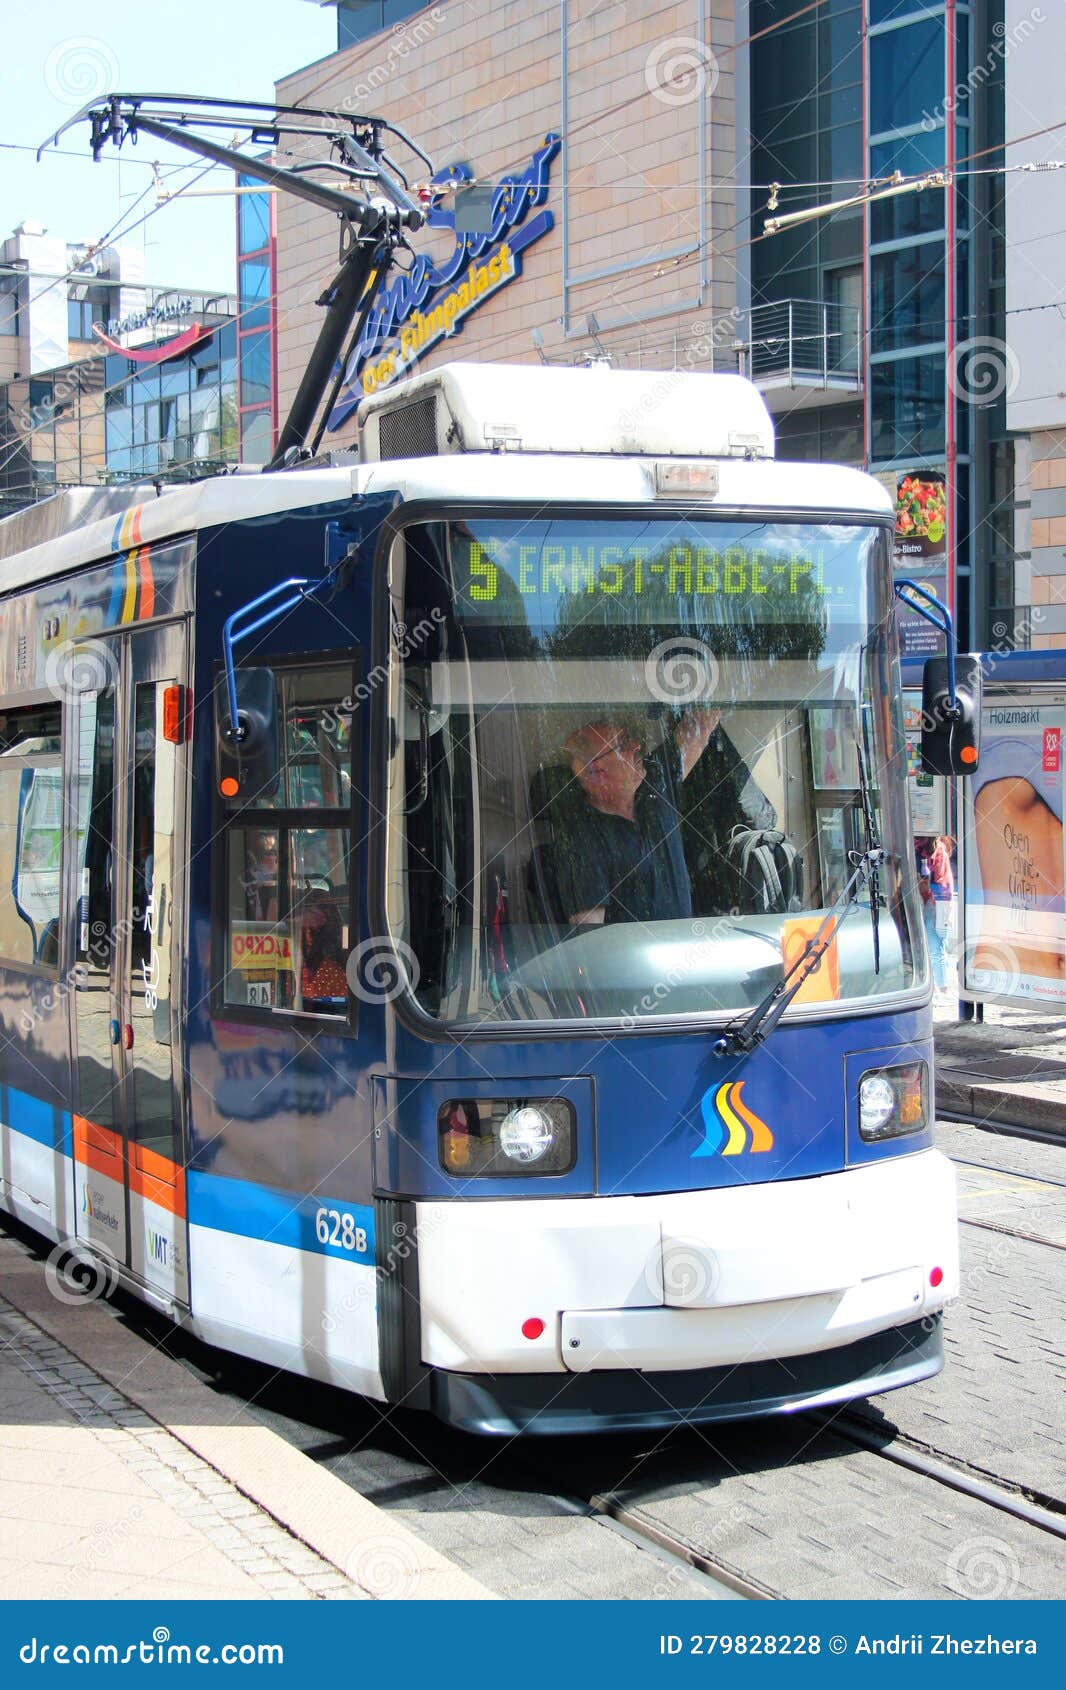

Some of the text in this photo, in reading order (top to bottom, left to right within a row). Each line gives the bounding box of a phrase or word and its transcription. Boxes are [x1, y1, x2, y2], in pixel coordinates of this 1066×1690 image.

[363, 243, 511, 395] Der Filmpalast
[469, 541, 845, 600] 5 ERNST-ABBE-PL.
[989, 709, 1040, 725] Holzmarkt
[1004, 823, 1030, 855] Oben
[1009, 873, 1037, 905] Unten
[148, 1227, 168, 1266] VMT
